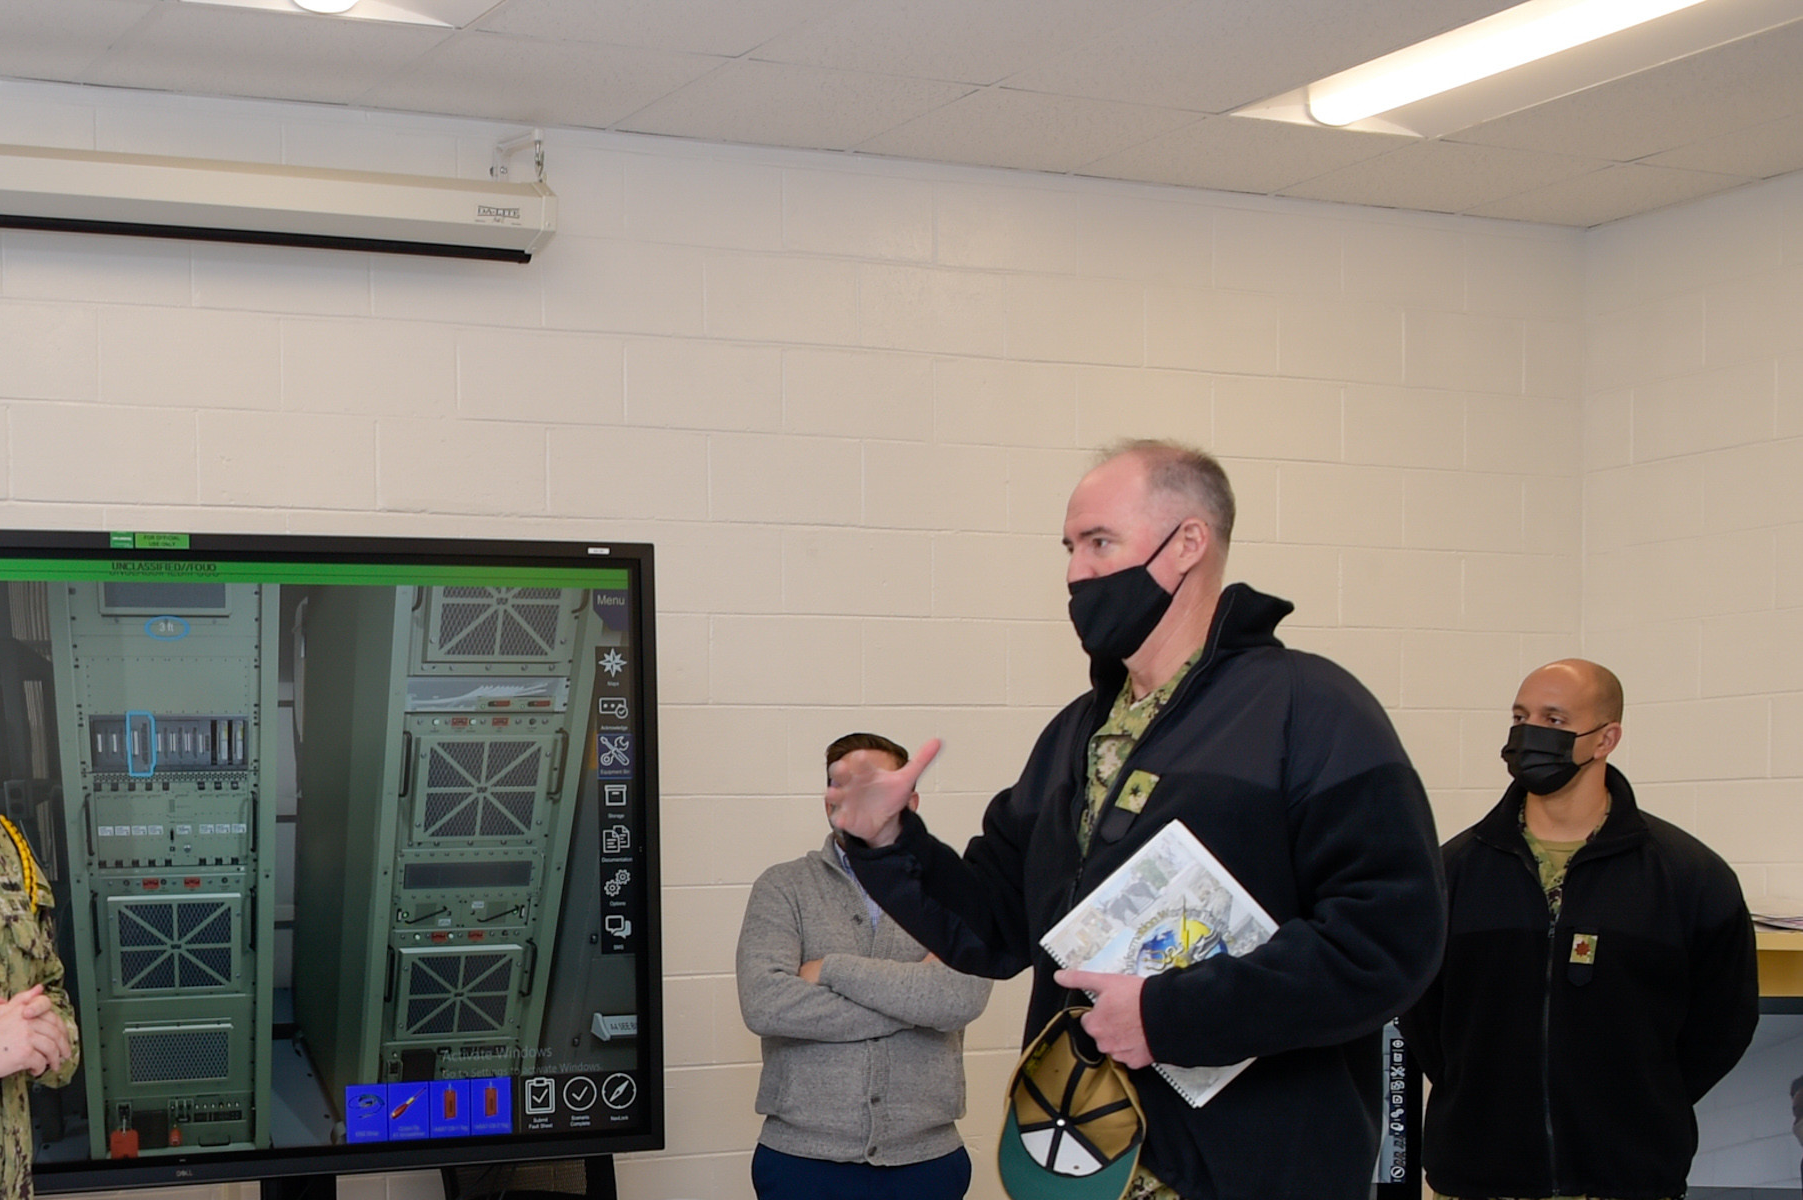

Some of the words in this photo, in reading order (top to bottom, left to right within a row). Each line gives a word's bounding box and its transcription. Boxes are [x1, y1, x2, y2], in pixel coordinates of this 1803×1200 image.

[597, 594, 625, 605] Menu
[159, 622, 165, 632] 3
[167, 622, 174, 632] ft
[443, 1047, 493, 1062] Activate
[496, 1046, 552, 1060] Windows
[442, 1070, 455, 1079] Go
[471, 1068, 508, 1080] Settings
[523, 1064, 557, 1075] activate
[560, 1062, 602, 1073] Windows.
